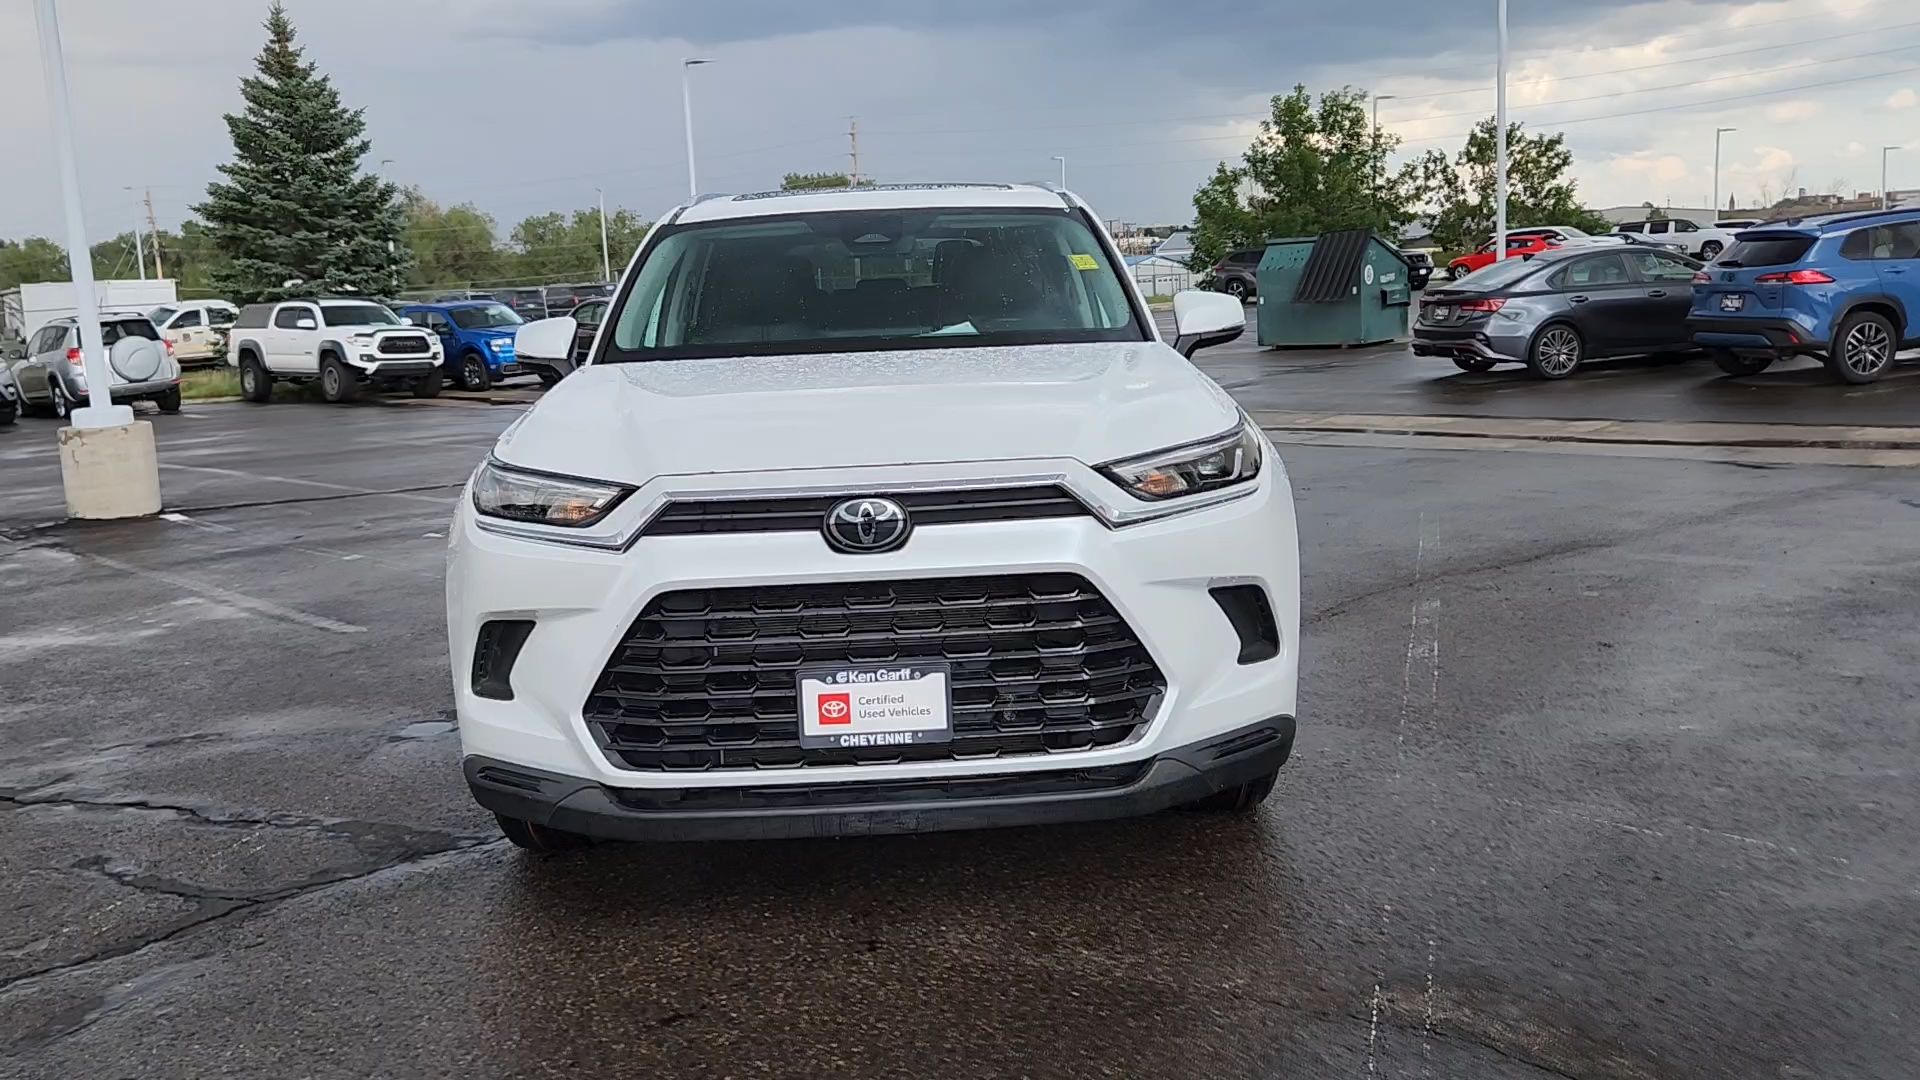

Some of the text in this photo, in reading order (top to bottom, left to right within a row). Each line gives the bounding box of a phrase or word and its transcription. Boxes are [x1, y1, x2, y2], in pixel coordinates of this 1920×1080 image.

[858, 694, 905, 706] Certified
[858, 706, 931, 719] Used Vehicles
[840, 732, 913, 747] CHEYENNE
